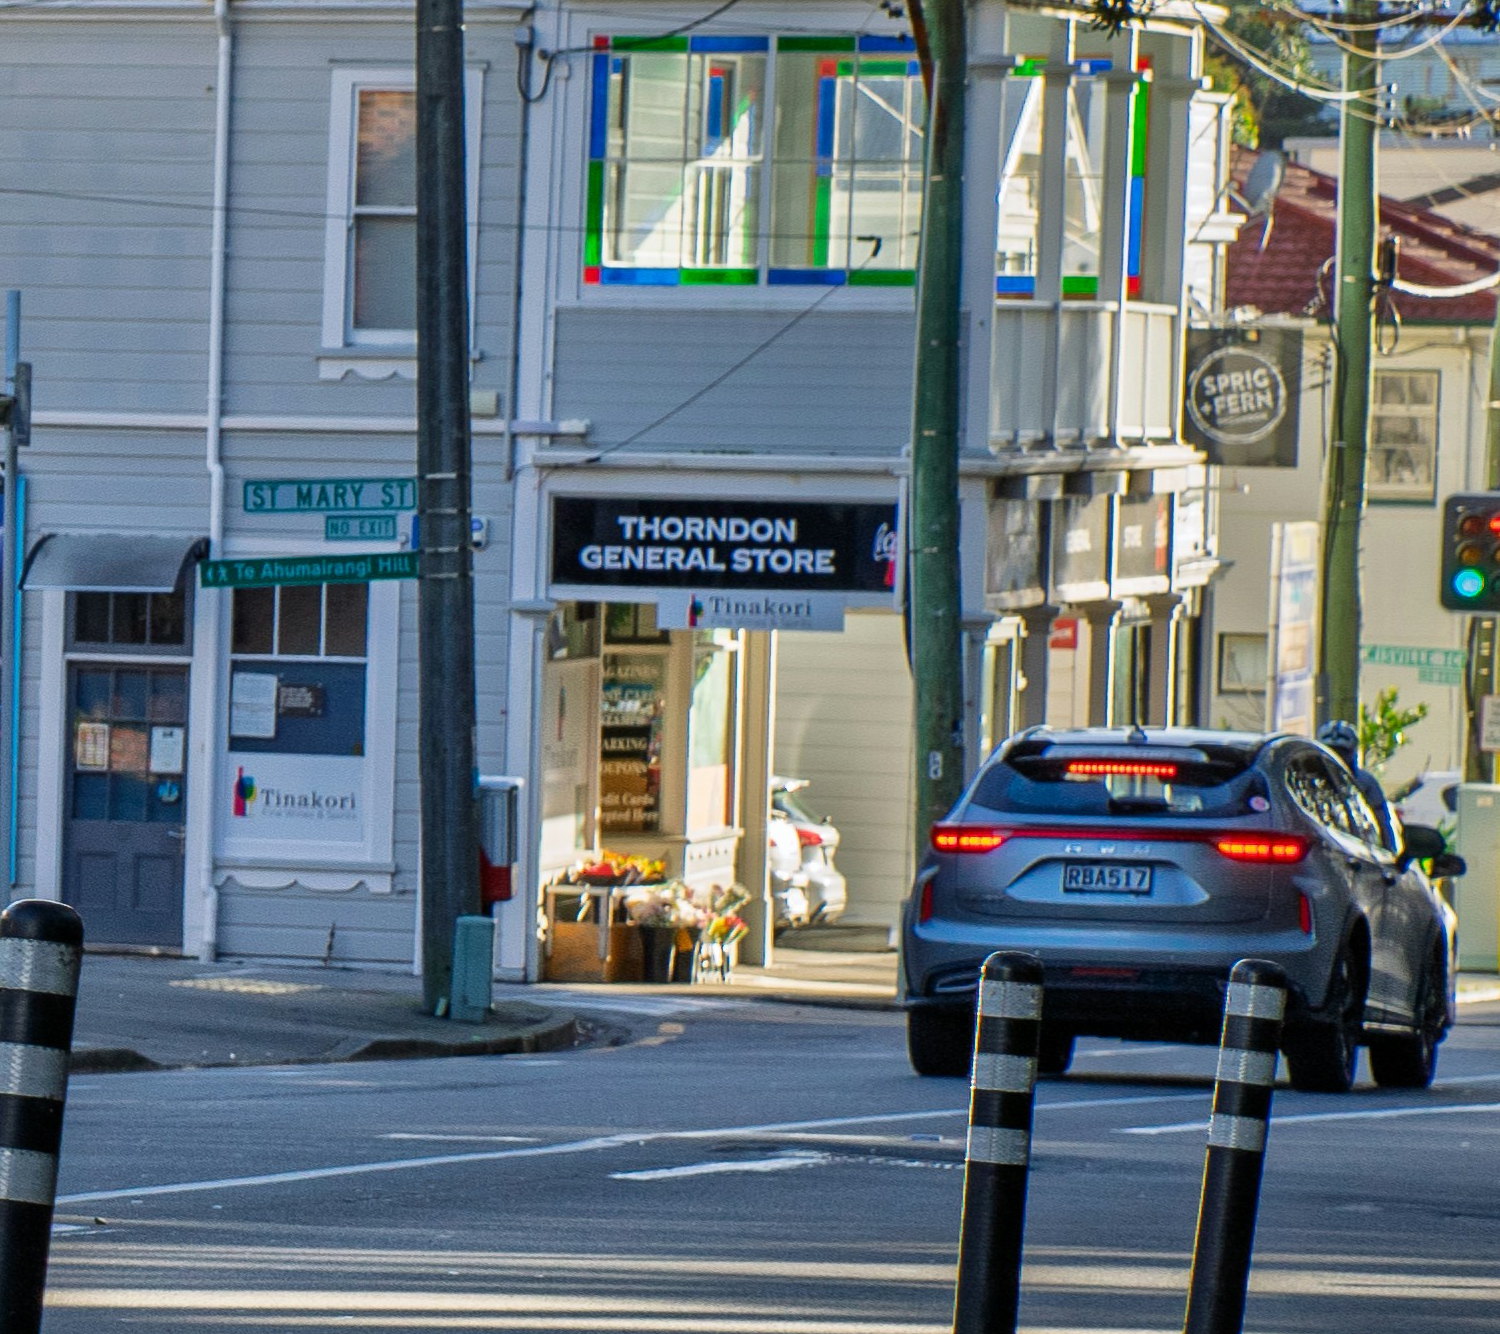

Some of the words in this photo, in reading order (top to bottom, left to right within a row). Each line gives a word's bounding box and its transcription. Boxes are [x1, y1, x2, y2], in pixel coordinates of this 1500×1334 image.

[1203, 368, 1270, 396] SPRIG
[252, 487, 278, 508] ST
[296, 485, 363, 507] MARY
[381, 481, 410, 507] ST
[329, 521, 349, 536] NO
[359, 520, 392, 537] EXIT
[617, 515, 798, 543] THORNDON
[236, 562, 256, 578] Te
[260, 557, 371, 579] Ahumairangi
[378, 554, 410, 573] Hill
[579, 545, 726, 571] GENERAL
[731, 548, 836, 574] STORE
[709, 597, 813, 618] Tinakori
[604, 737, 647, 752] ARKING
[261, 788, 356, 810] Tinakori
[1068, 868, 1147, 887] RBA517
